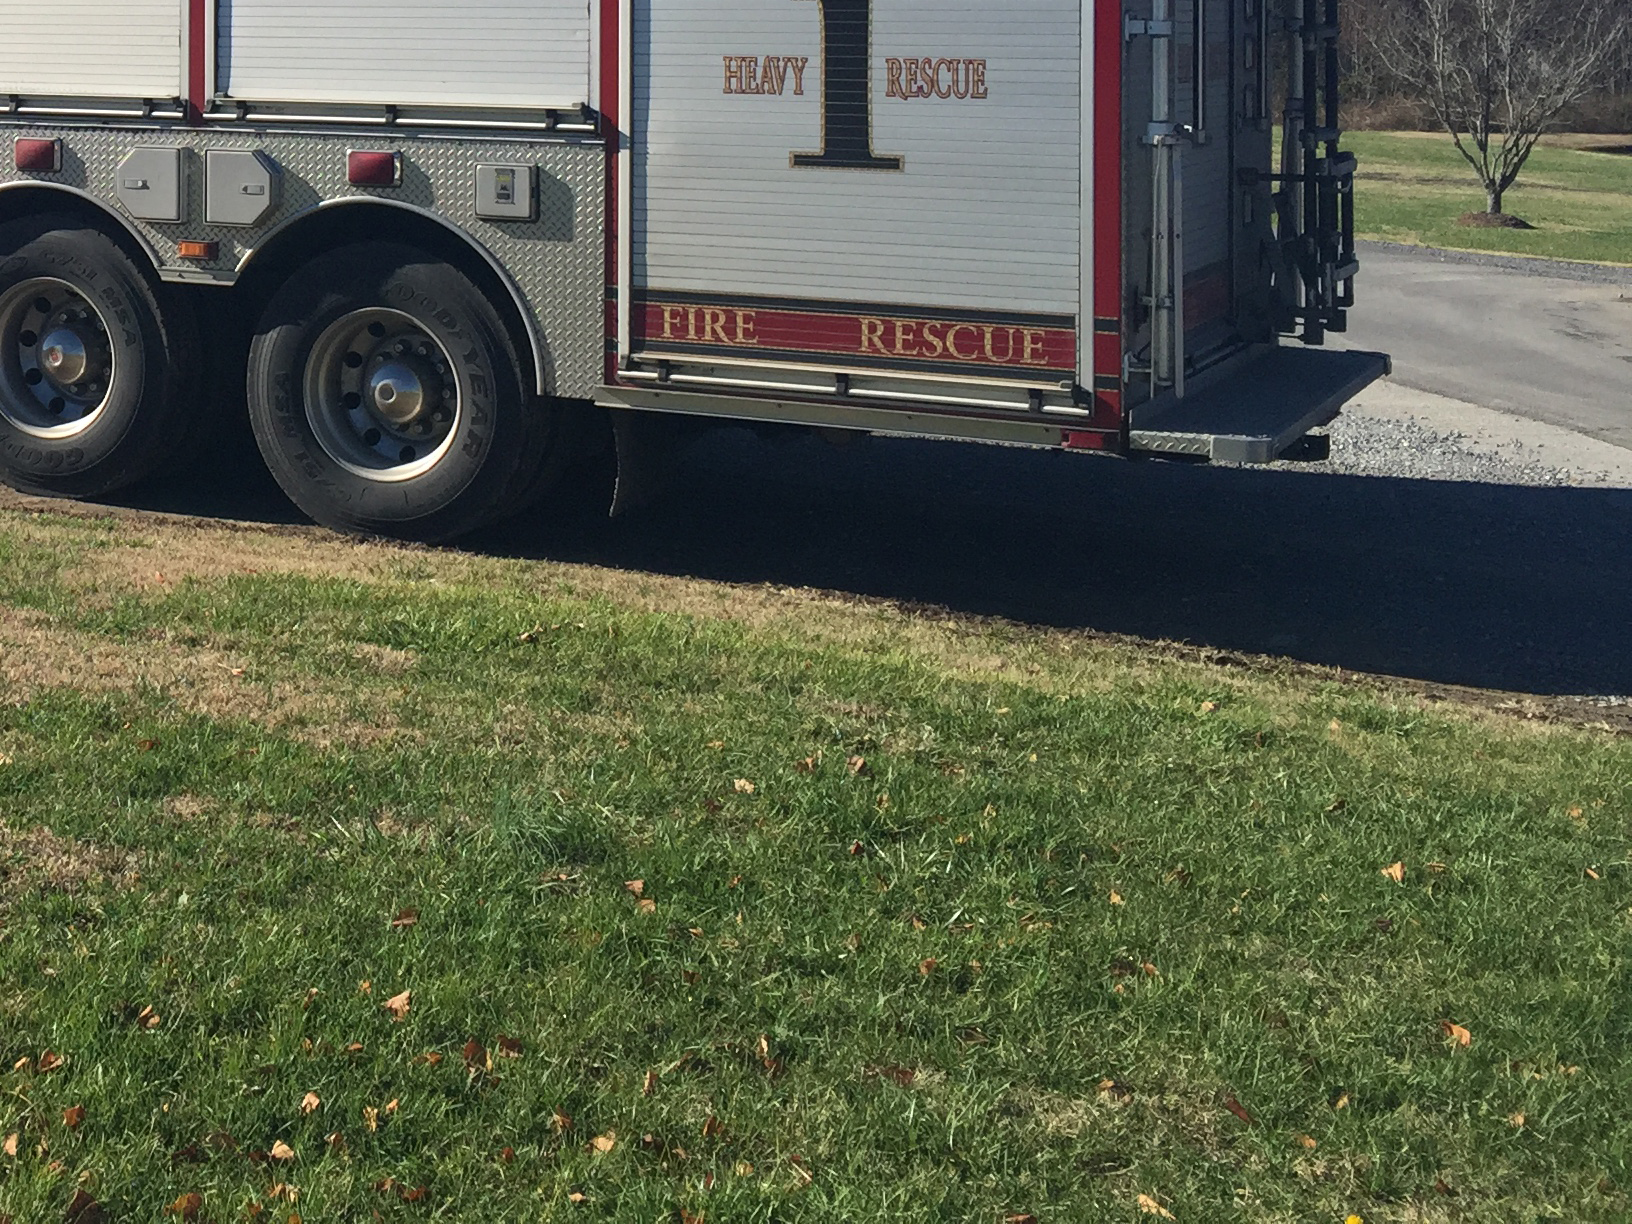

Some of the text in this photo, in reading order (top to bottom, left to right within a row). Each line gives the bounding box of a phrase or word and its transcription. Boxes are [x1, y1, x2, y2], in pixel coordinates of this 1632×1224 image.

[722, 55, 808, 96] HEAVY
[885, 58, 988, 101] RESCUE
[660, 305, 1050, 365] FIRE RESCUE
